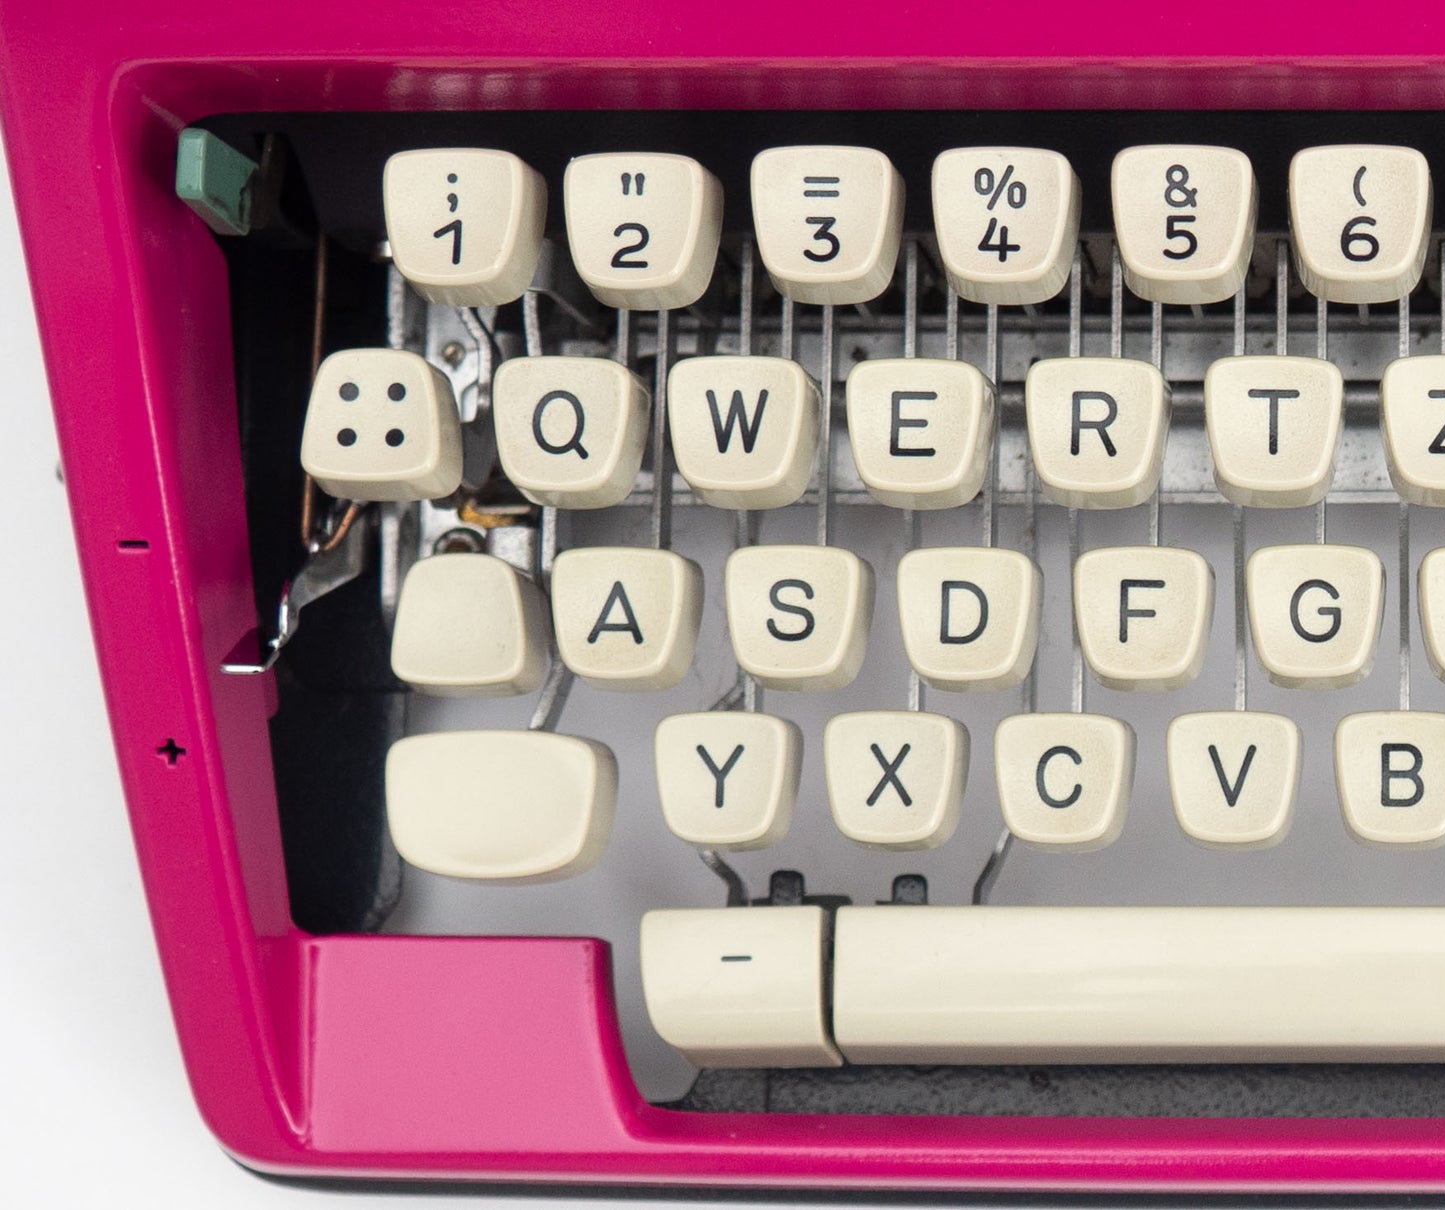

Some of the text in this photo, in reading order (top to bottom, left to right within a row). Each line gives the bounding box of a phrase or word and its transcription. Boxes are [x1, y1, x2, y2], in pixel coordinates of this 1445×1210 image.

[446, 173, 459, 212] ;
[804, 177, 840, 197] =
[975, 165, 1026, 210] %
[1165, 165, 1197, 207] &
[1352, 166, 1367, 206] (
[434, 220, 462, 265] 1
[611, 223, 649, 268] 2
[803, 217, 840, 262] 3
[978, 218, 1020, 262] 4
[1163, 215, 1197, 260] 5
[1341, 216, 1379, 262] 6
[532, 390, 588, 459] Q
[706, 389, 768, 453] W
[890, 391, 937, 457] E
[1071, 391, 1117, 457] R
[1248, 389, 1300, 455] T
[587, 581, 643, 644] A
[767, 579, 815, 641] S
[940, 581, 988, 644] D
[1119, 579, 1165, 643] F
[1290, 579, 1341, 643] G
[697, 745, 744, 808] Y
[866, 744, 912, 806] X
[1036, 746, 1082, 808] C
[1208, 745, 1256, 807] V
[1381, 743, 1424, 807] B
